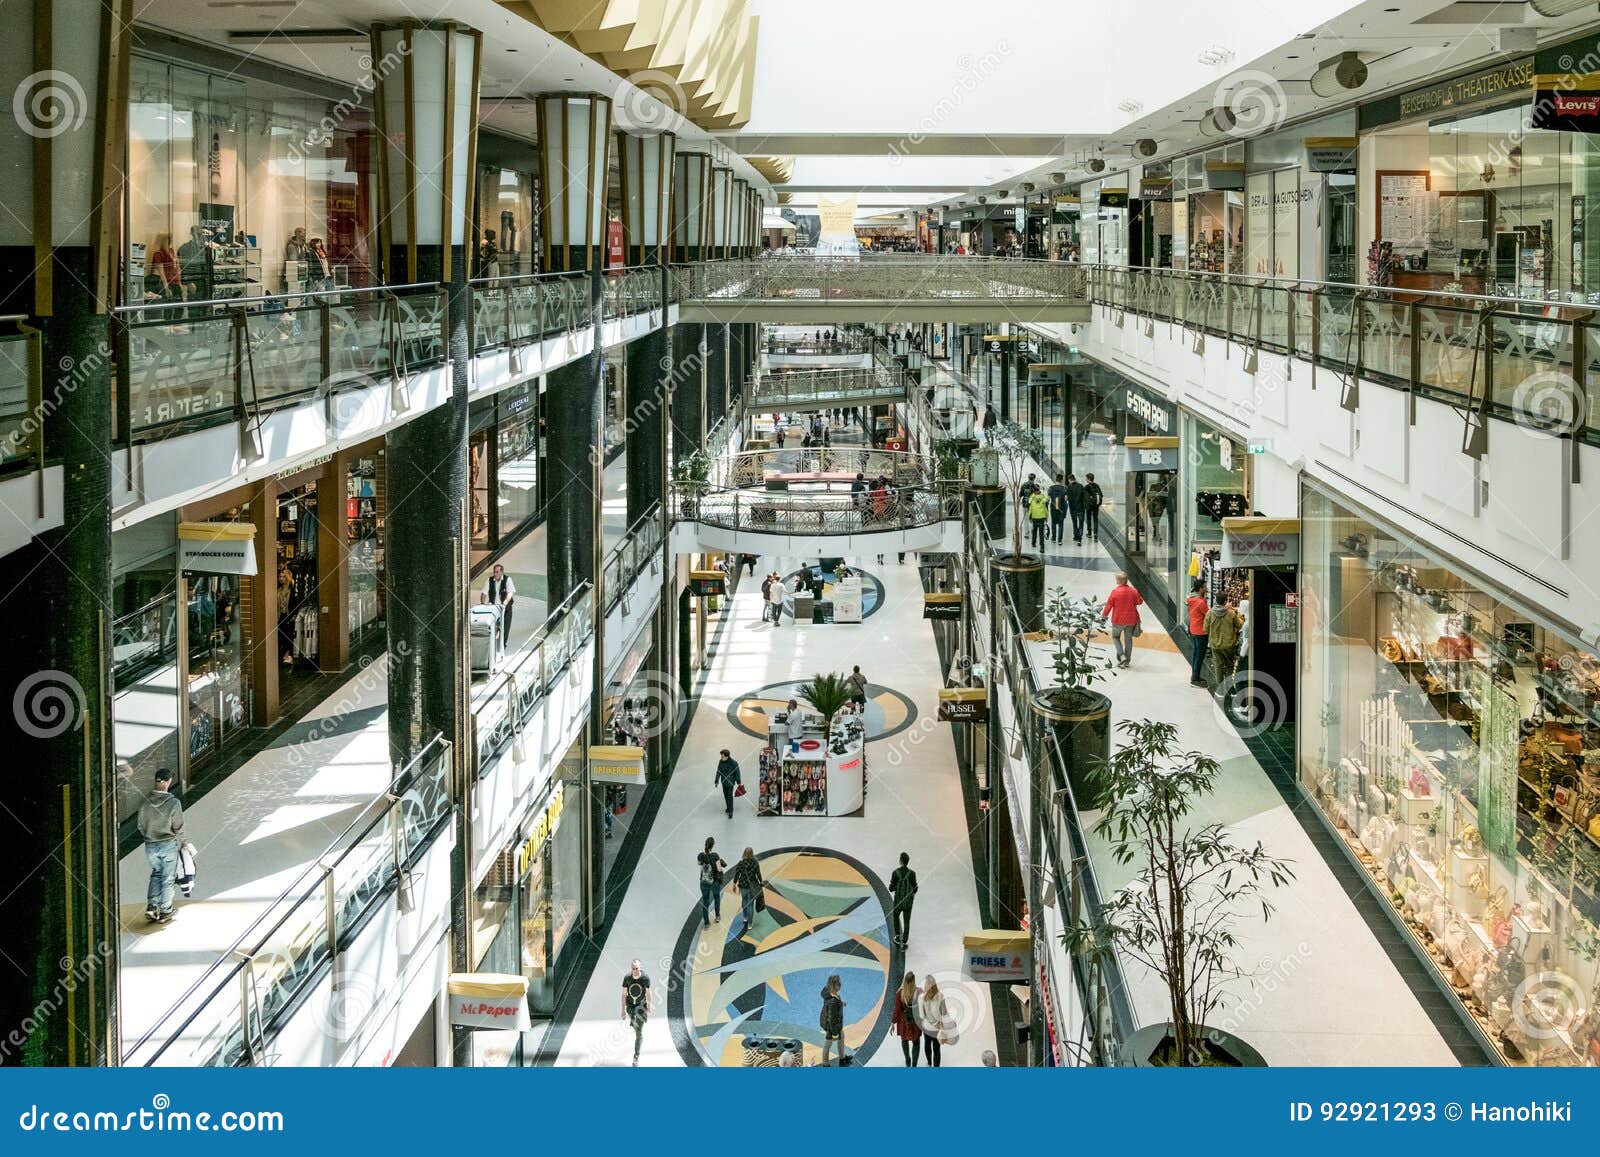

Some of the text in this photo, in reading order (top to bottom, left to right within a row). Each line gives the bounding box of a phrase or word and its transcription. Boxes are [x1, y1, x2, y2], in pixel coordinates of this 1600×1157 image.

[1401, 64, 1532, 115] REISEPROFI & THEATERKASSE
[1126, 389, 1169, 432] G-STAR RAW
[1231, 541, 1288, 552] TOP TWO
[947, 704, 977, 713] HUSSEL
[971, 957, 1006, 967] FRIESE
[460, 1003, 519, 1017] McPaper
